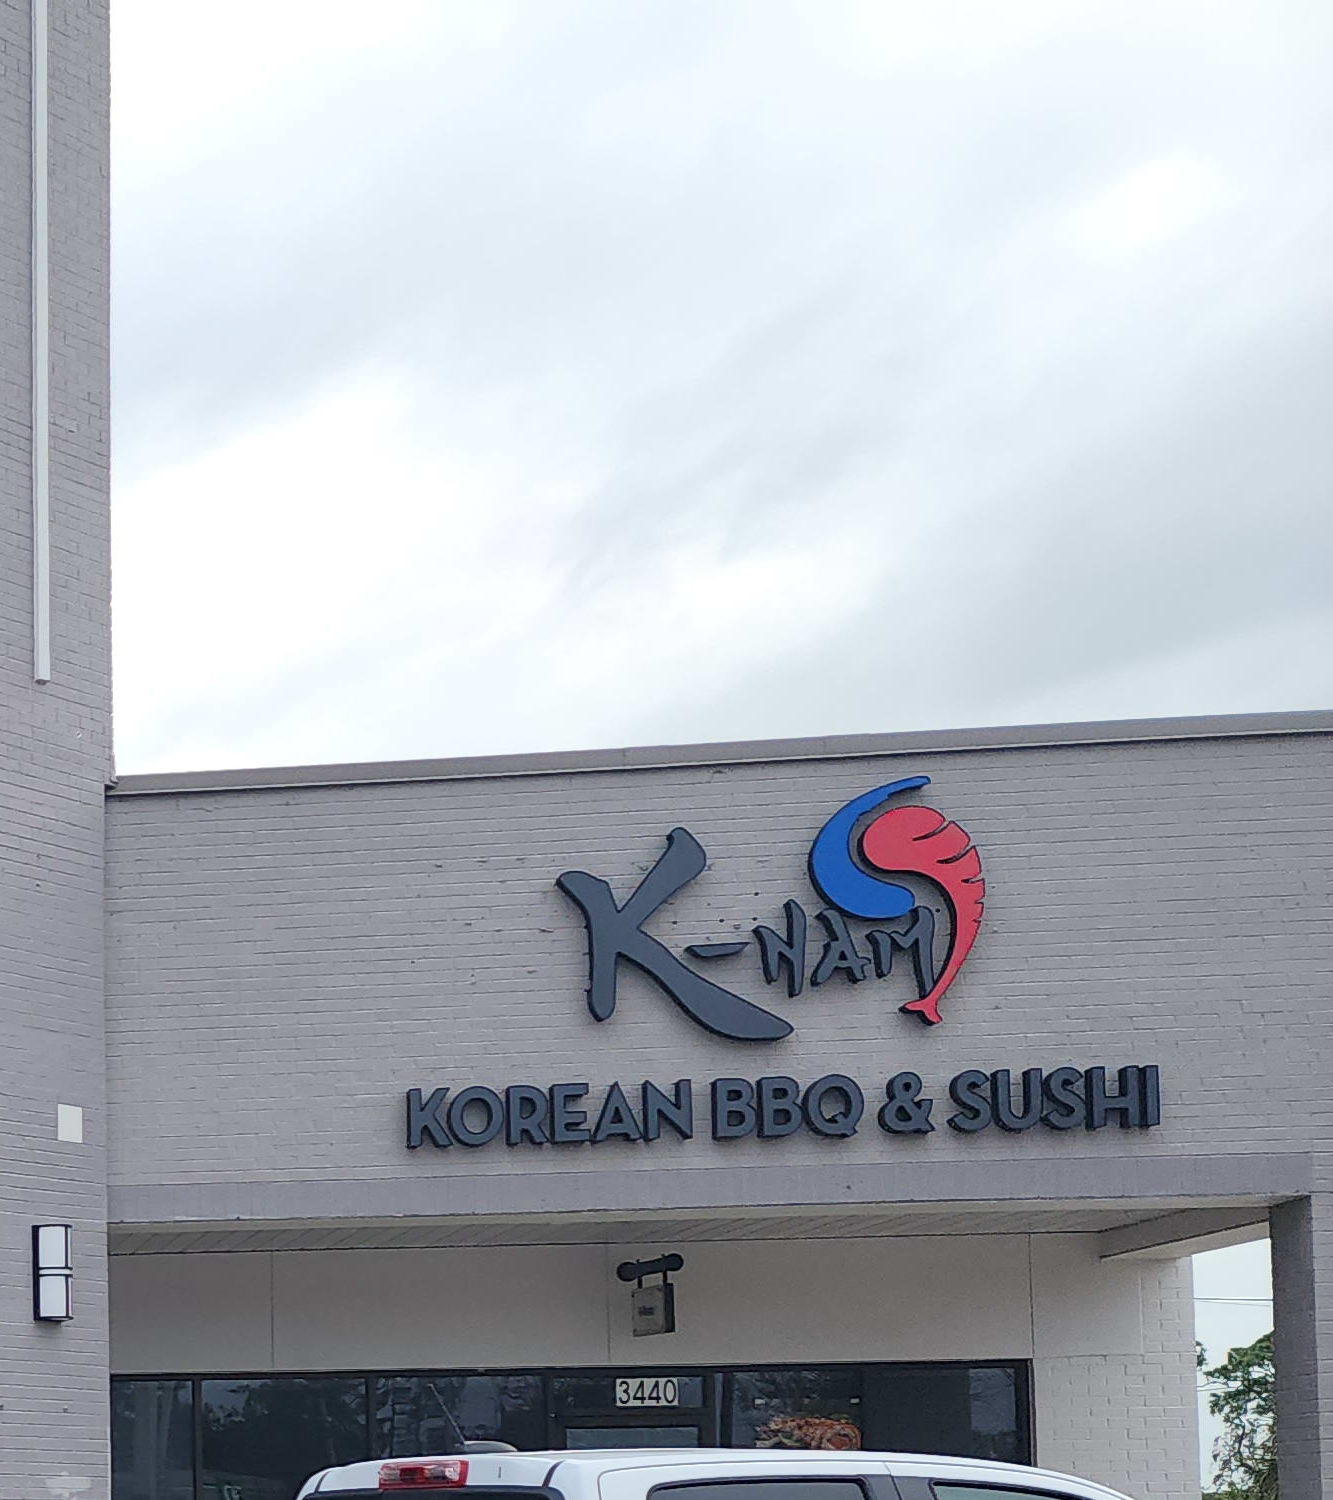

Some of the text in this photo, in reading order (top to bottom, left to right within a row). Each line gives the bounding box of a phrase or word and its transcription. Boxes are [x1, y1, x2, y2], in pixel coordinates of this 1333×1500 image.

[406, 1064, 1161, 1149] KOREAN BBQ & SUSHI
[618, 1379, 677, 1404] 3440
